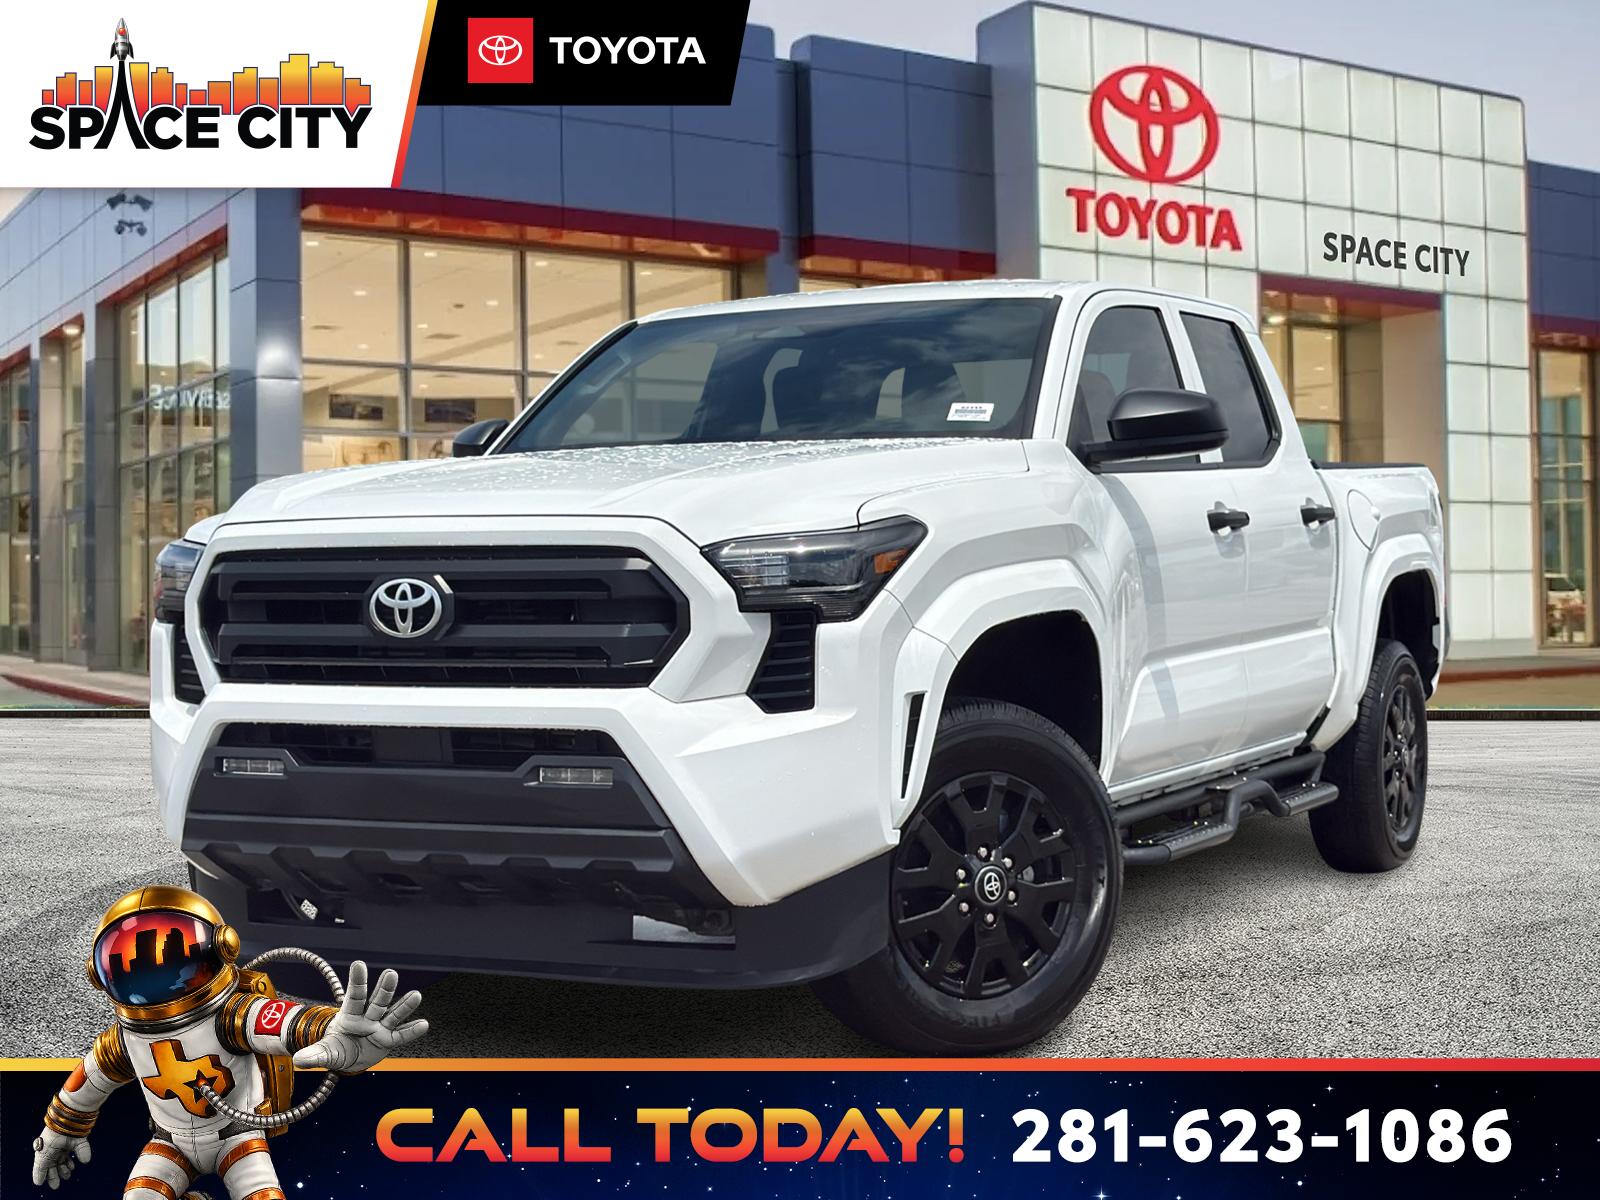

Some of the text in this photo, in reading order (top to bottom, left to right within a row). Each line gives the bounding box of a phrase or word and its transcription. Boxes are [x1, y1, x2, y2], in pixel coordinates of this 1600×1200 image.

[1066, 188, 1242, 252] TOYOTA
[1323, 232, 1470, 277] SPACE CITY
